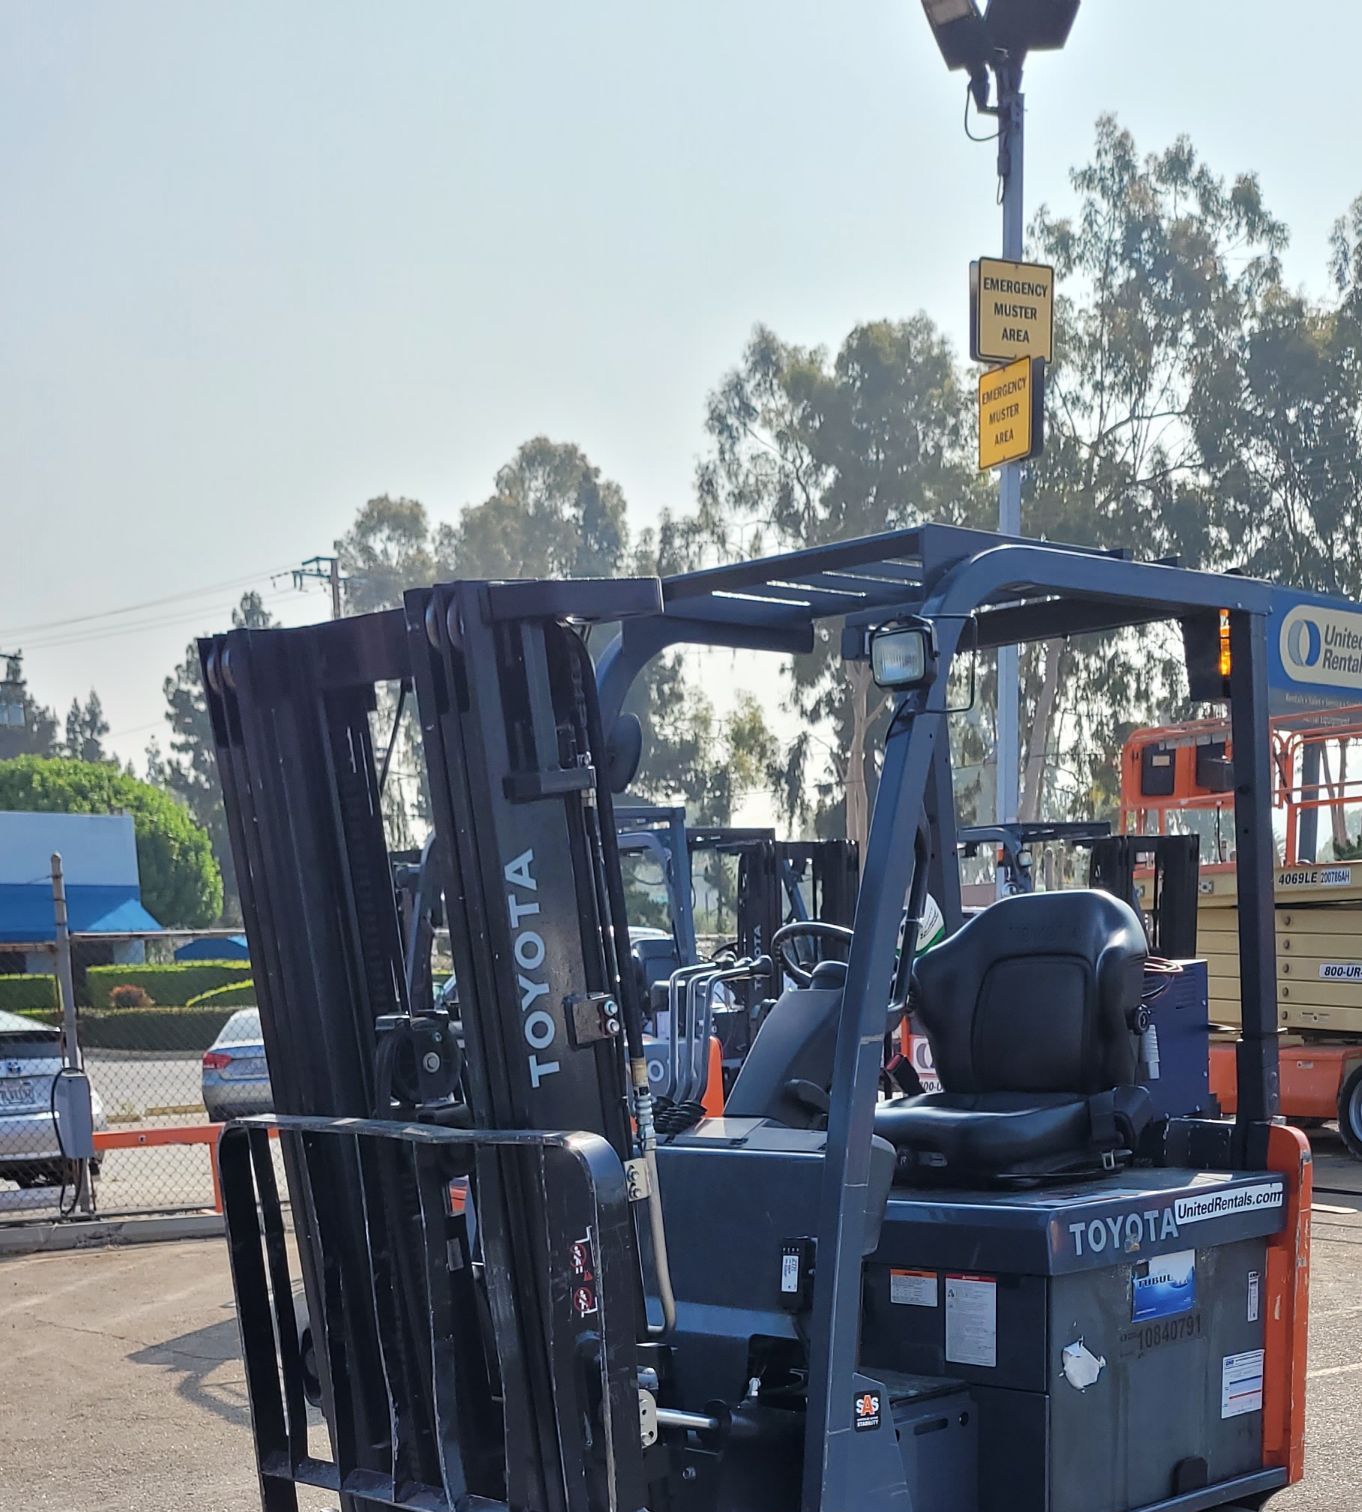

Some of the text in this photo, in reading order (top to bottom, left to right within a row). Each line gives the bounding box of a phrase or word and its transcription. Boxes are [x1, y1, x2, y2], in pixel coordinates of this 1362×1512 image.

[983, 276, 1048, 298] EMERGENCY
[994, 302, 1037, 320] MUSTER
[1002, 326, 1030, 343] AREA
[982, 376, 1027, 405] EMERGENCY
[989, 402, 1019, 425] MUSTER
[994, 428, 1014, 446] AREA
[1279, 872, 1318, 885] 4069LE
[504, 848, 561, 1088] TOYOTA
[754, 924, 762, 991] TOTA
[1178, 1191, 1283, 1219] UnitedRentals.com
[1069, 1207, 1179, 1256] TOYOTA
[856, 1394, 879, 1417] SAS
